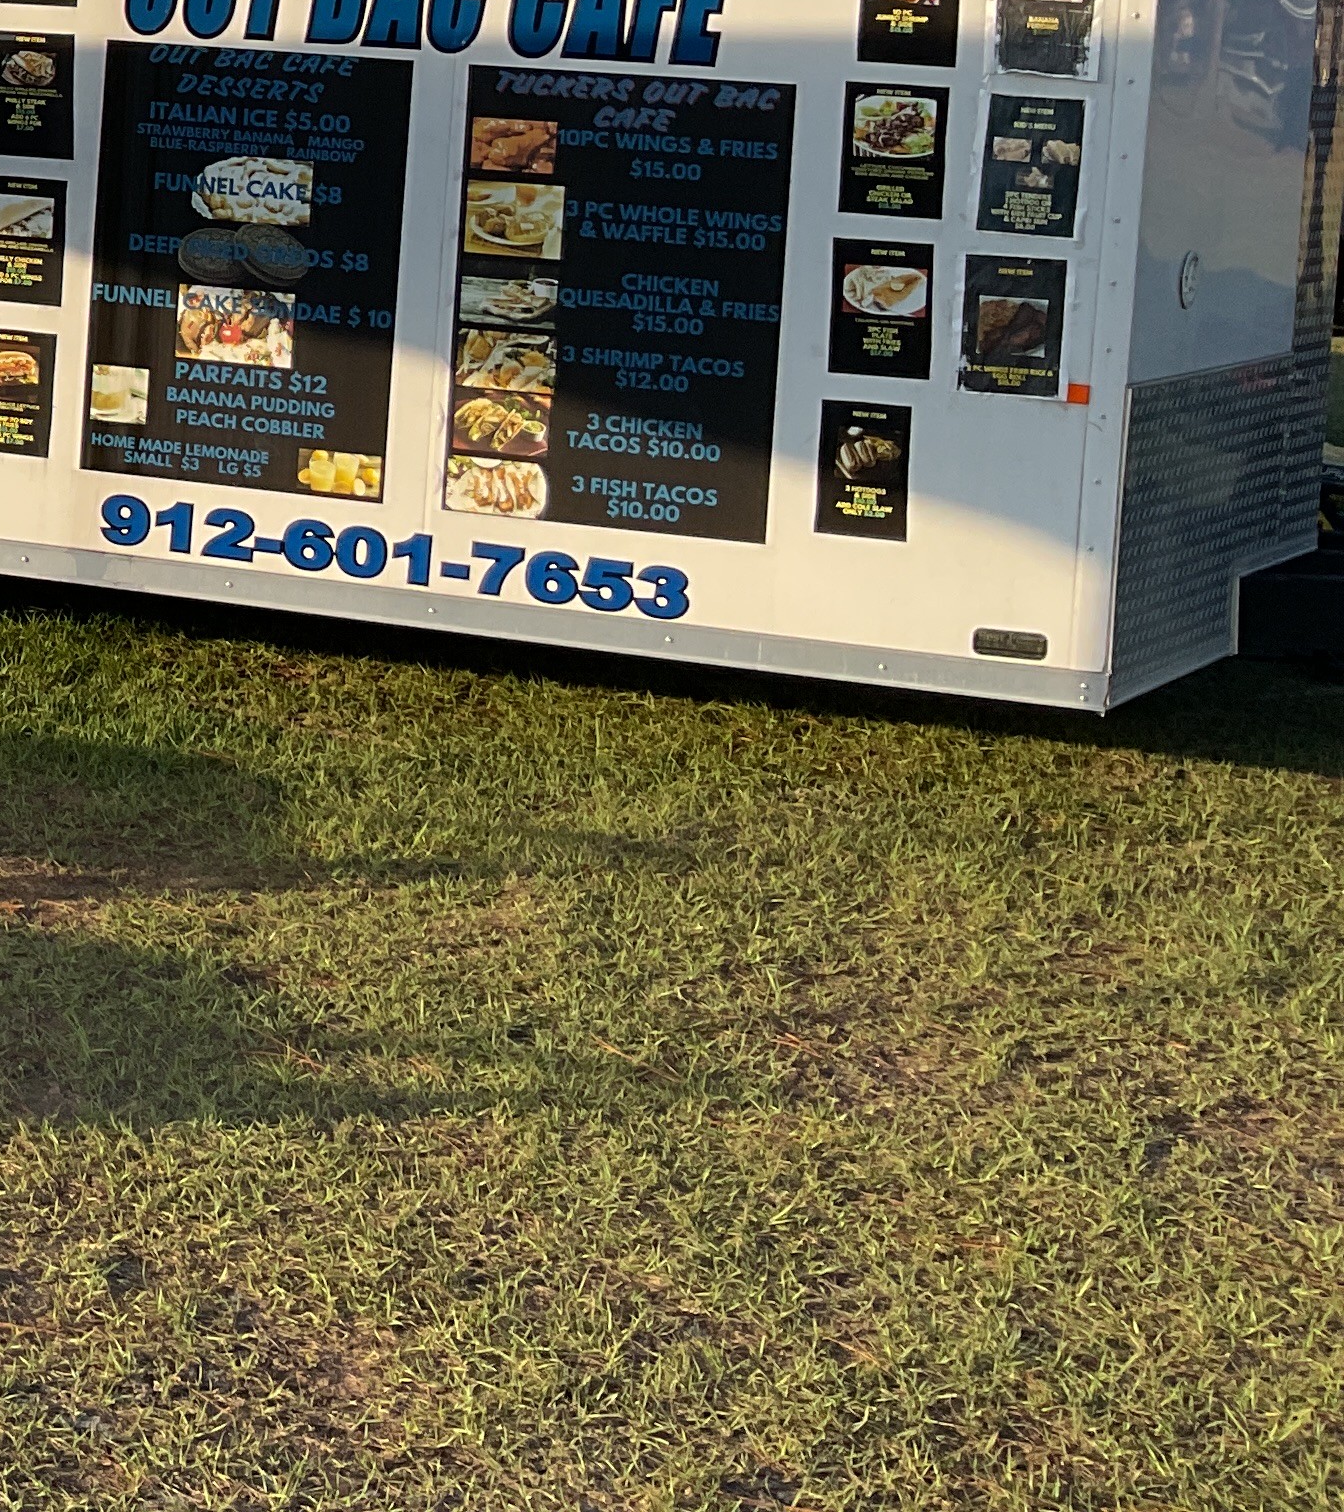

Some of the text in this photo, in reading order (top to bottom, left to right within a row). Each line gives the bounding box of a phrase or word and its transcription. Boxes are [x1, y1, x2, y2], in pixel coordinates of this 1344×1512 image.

[148, 43, 360, 78] OUT BAC CAFE
[177, 72, 325, 105] DESSERTS
[495, 70, 781, 112] TUCKERS OUT BAC
[150, 101, 351, 134] ITALIAN ICE $5.00
[592, 106, 678, 134] CAFE
[137, 121, 366, 152] STRAWBERRY BANANA MANGO
[150, 136, 358, 163] BLUE-RASPBERRY RAINBOW
[558, 129, 779, 161] 10PC WINGS & FRIES
[629, 159, 702, 181] $15.00
[154, 172, 343, 206] FUNNEL CAKE $8
[565, 199, 783, 234] 3 PC WHOLE WINGS
[128, 232, 182, 255] DEEP
[340, 250, 369, 273] $8
[579, 220, 767, 253] & WAFFLE $15.00
[621, 273, 720, 298] CHICKEN
[92, 283, 176, 309] FUNNEL
[183, 292, 242, 316] CAKE
[348, 305, 361, 328] $
[368, 309, 392, 329] 10
[559, 286, 780, 324] QUESADILLA & FRIES
[632, 312, 705, 336] $15.00
[175, 361, 328, 395] PARFAITS $12
[562, 345, 746, 379] 3 SHRIMP TACOS
[615, 368, 689, 394] $12.00
[166, 386, 335, 419] BANANA PUDDING
[176, 408, 326, 440] PEACH COBBLER
[586, 412, 704, 441] 3 CHICKEN
[91, 432, 269, 465] HOME MADE LEMONADE
[566, 429, 721, 463] TACOS $10.00
[124, 450, 263, 478] SMALL $3 LG $5
[571, 475, 718, 507] 3 FISH TACOS
[606, 499, 681, 523] $10.00
[100, 492, 691, 621] 912-601-7653
